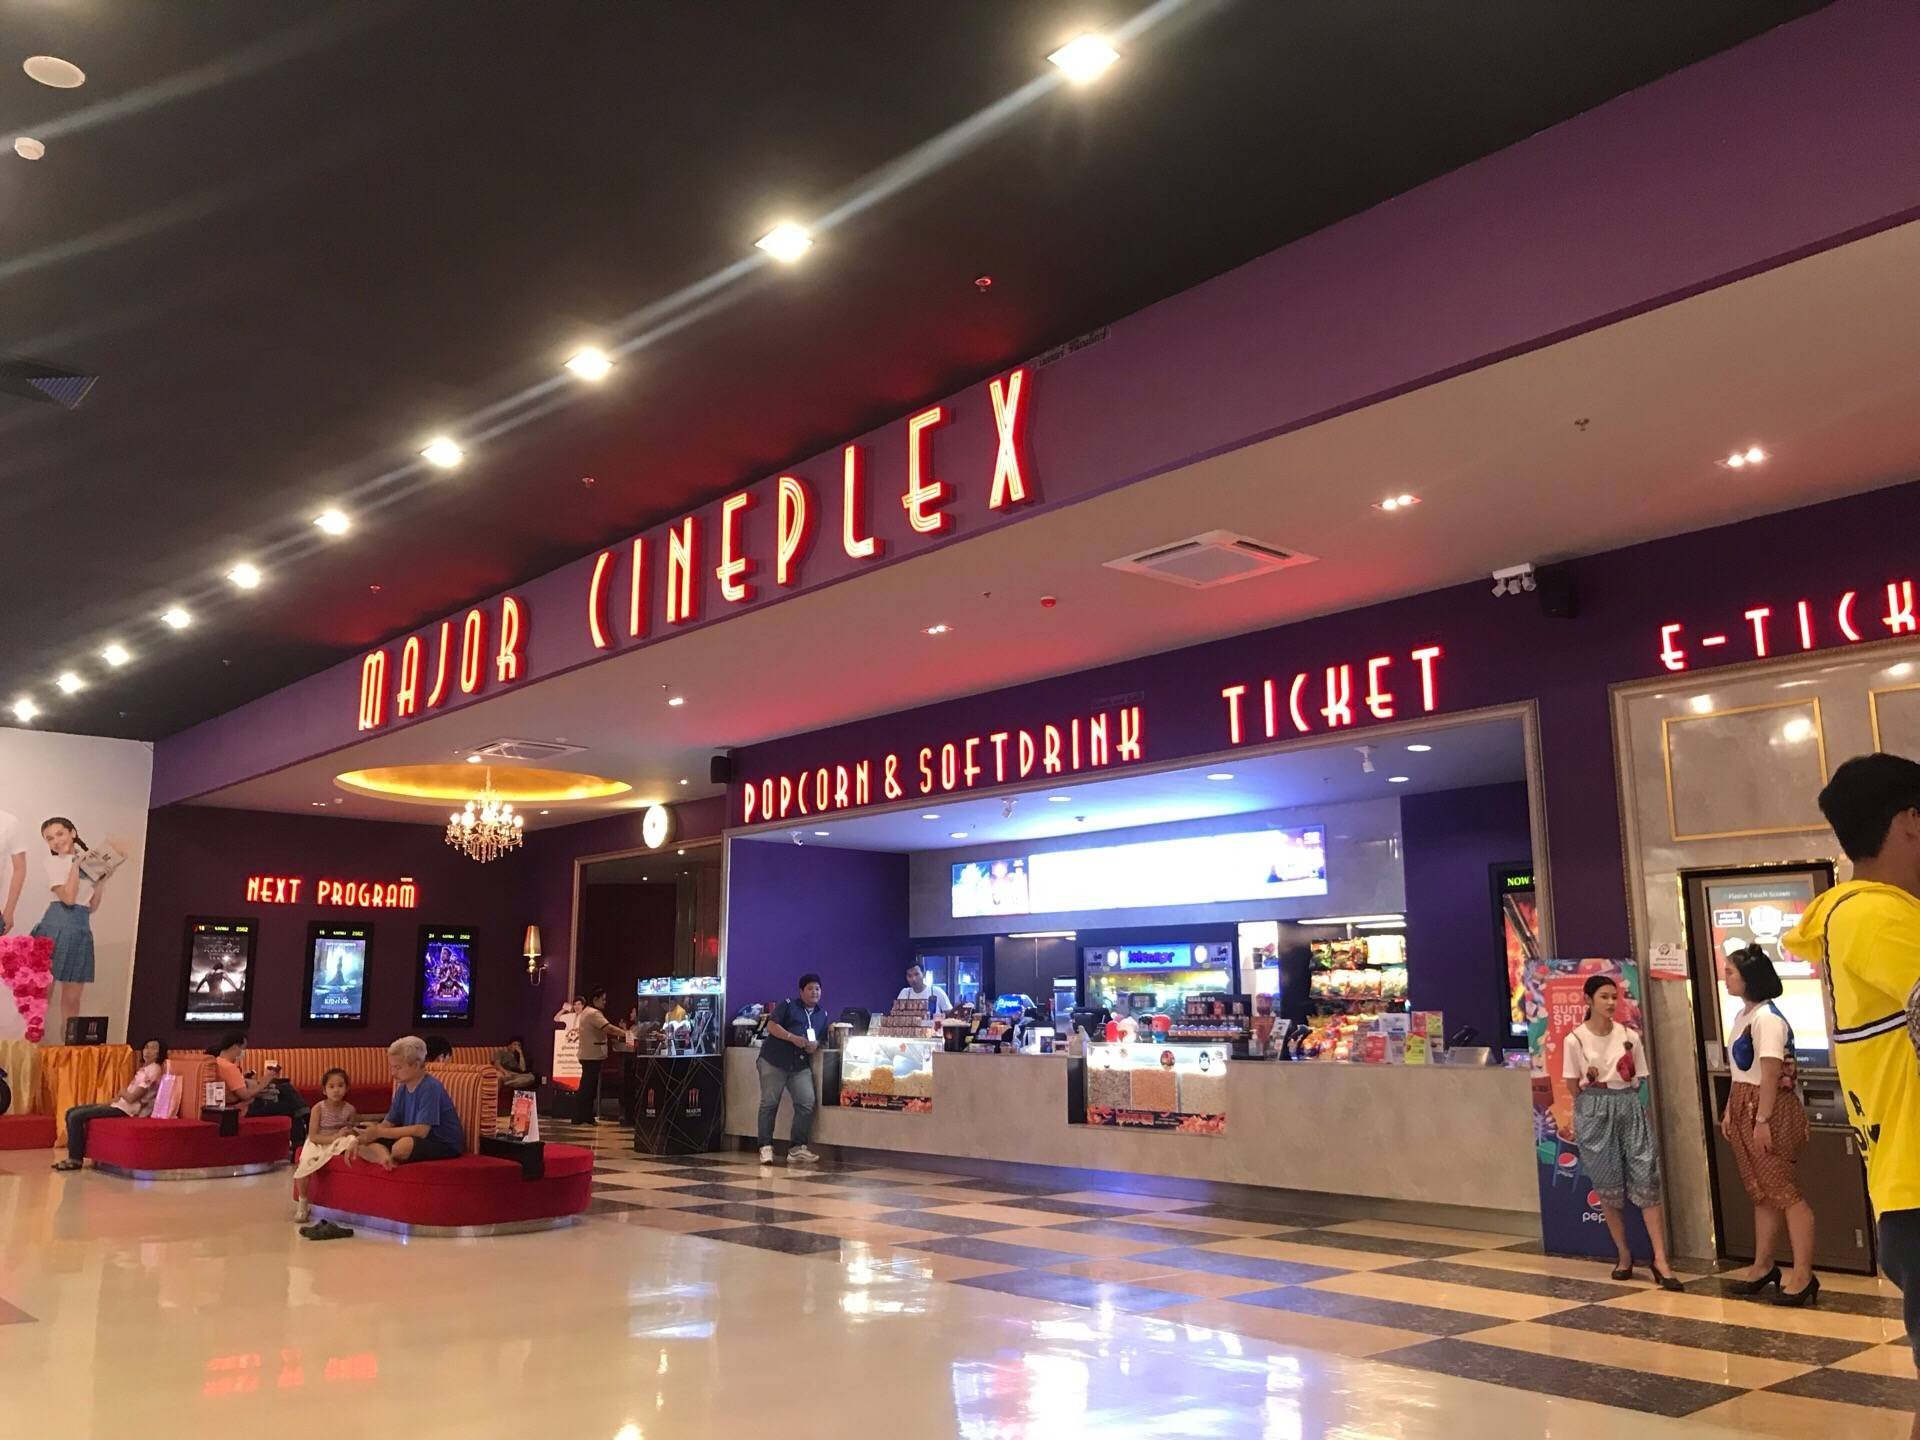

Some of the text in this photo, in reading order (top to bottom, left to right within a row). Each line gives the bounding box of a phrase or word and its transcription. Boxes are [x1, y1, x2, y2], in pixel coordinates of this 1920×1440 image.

[358, 369, 1027, 731] MAJOR CINEPLEX
[1660, 581, 1917, 670] E-TICK
[1222, 647, 1440, 744] TICKET
[744, 707, 1141, 824] POPCORN & SOFTDRINK
[247, 877, 415, 908] NEXT PROGRAM
[1507, 876, 1530, 886] NOW
[1553, 1014, 1584, 1026] SPL
[1582, 1211, 1606, 1224] pep
